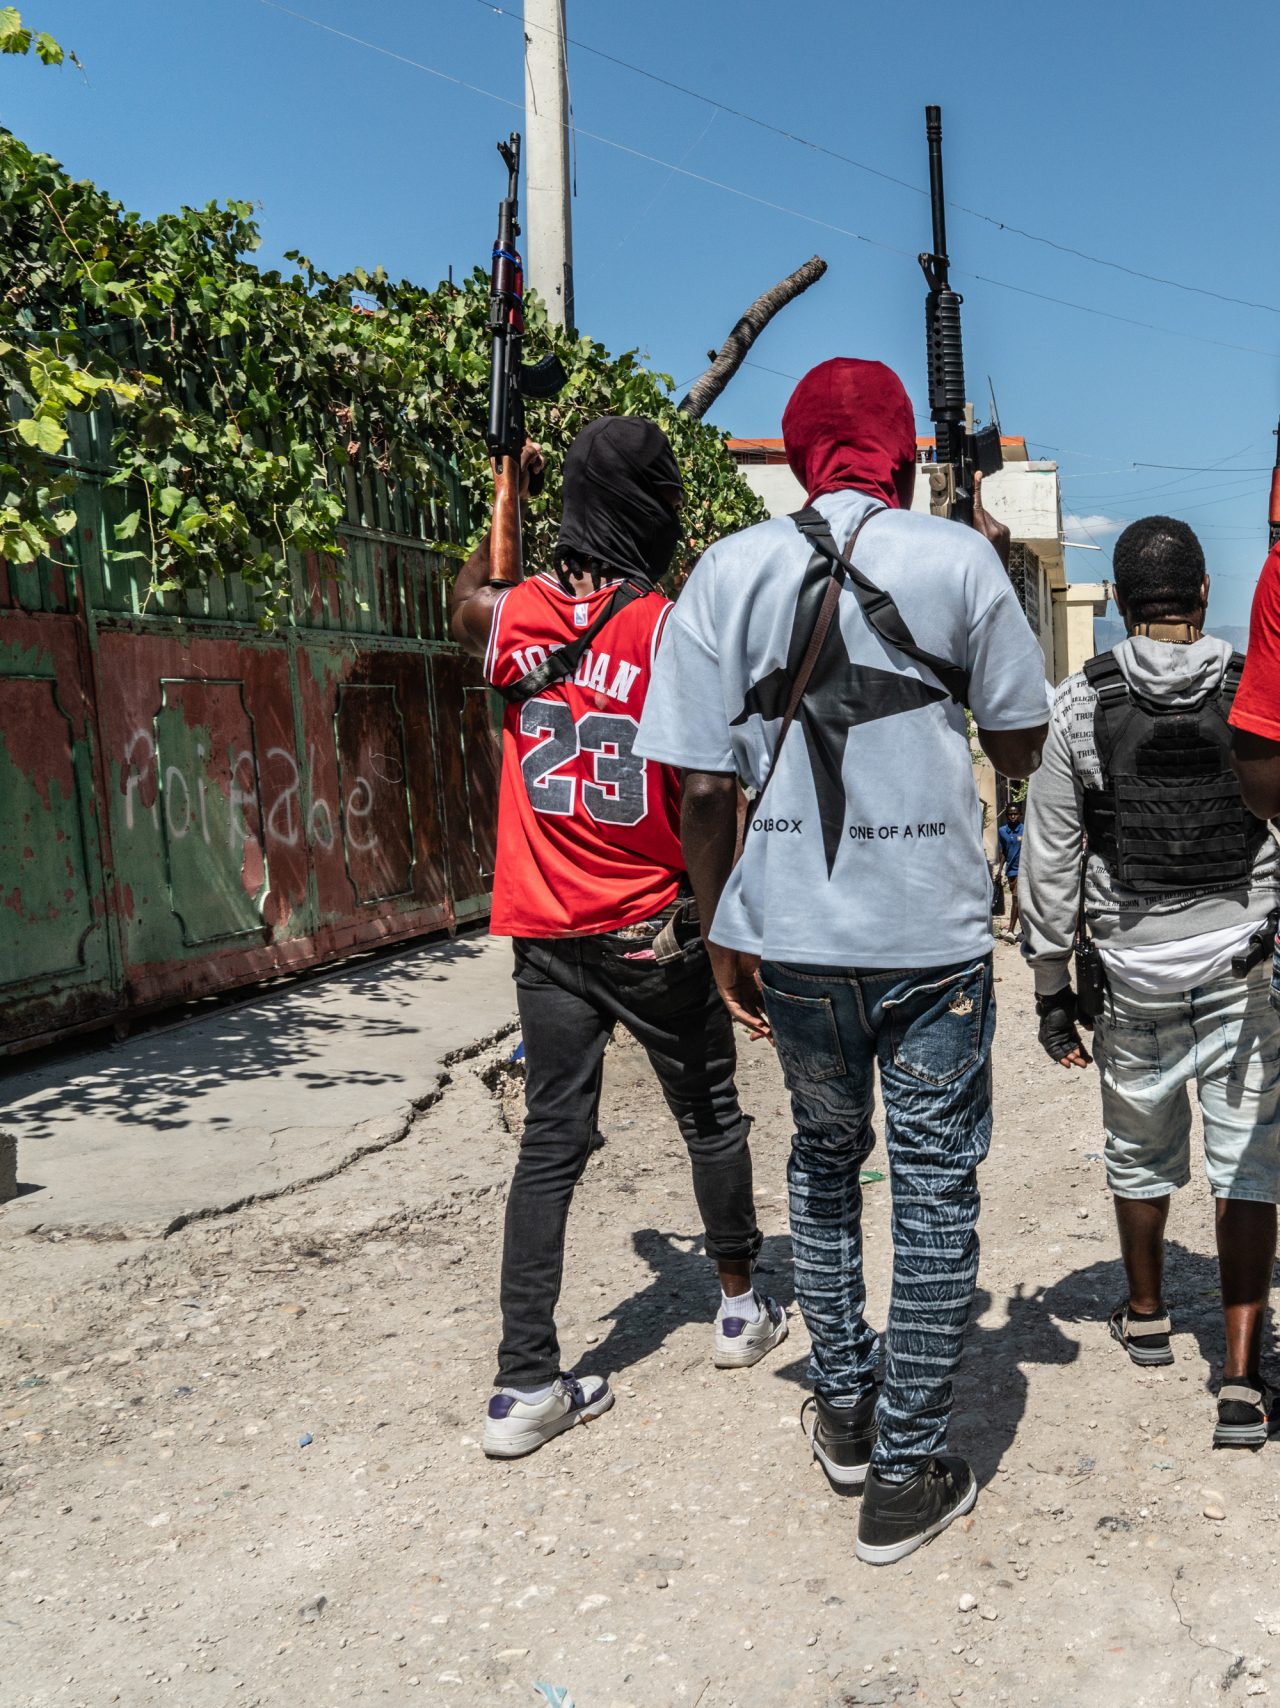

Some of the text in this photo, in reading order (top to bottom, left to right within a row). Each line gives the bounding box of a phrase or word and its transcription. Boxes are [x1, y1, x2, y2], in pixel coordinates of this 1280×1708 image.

[520, 697, 648, 827] 23
[849, 822, 946, 839] ONE OF A KIND
